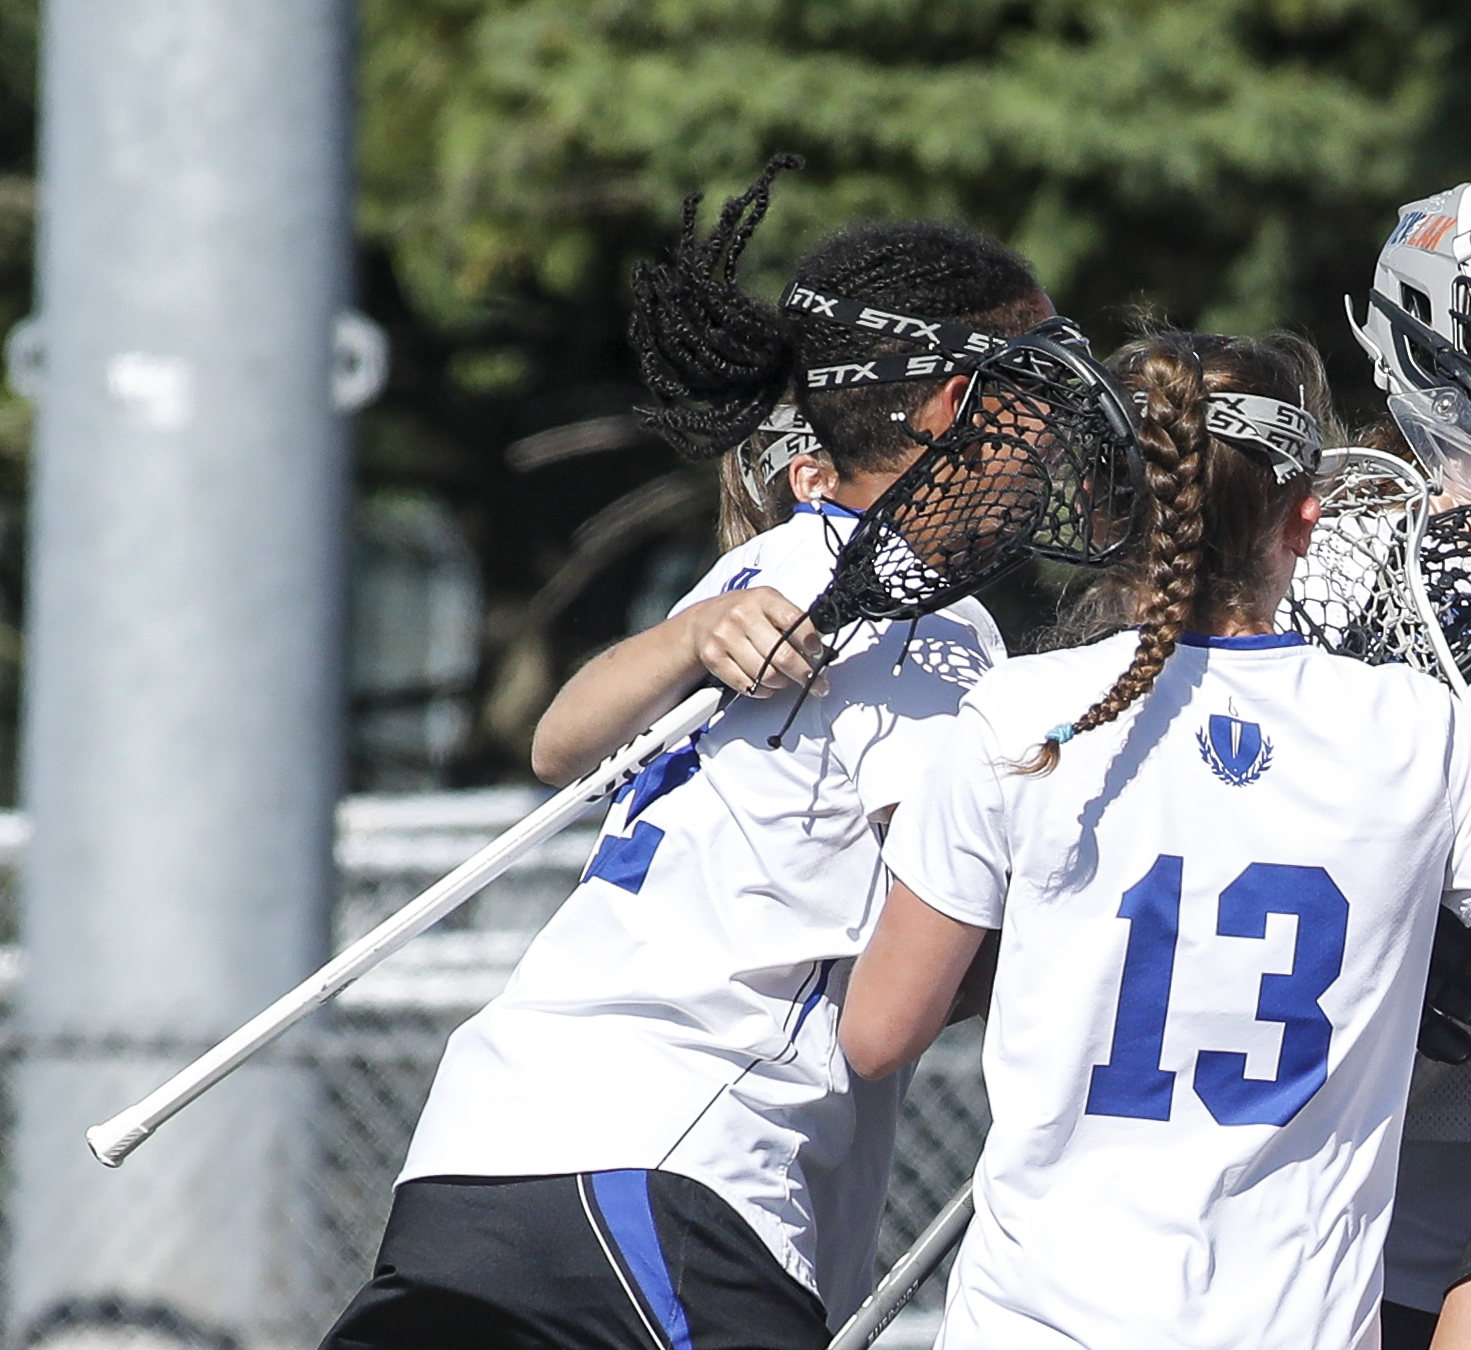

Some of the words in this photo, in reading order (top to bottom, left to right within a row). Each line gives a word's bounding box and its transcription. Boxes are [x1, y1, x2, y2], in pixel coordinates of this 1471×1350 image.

[855, 307, 942, 344] STX
[807, 361, 879, 389] STX
[1084, 853, 1351, 1128] 13
